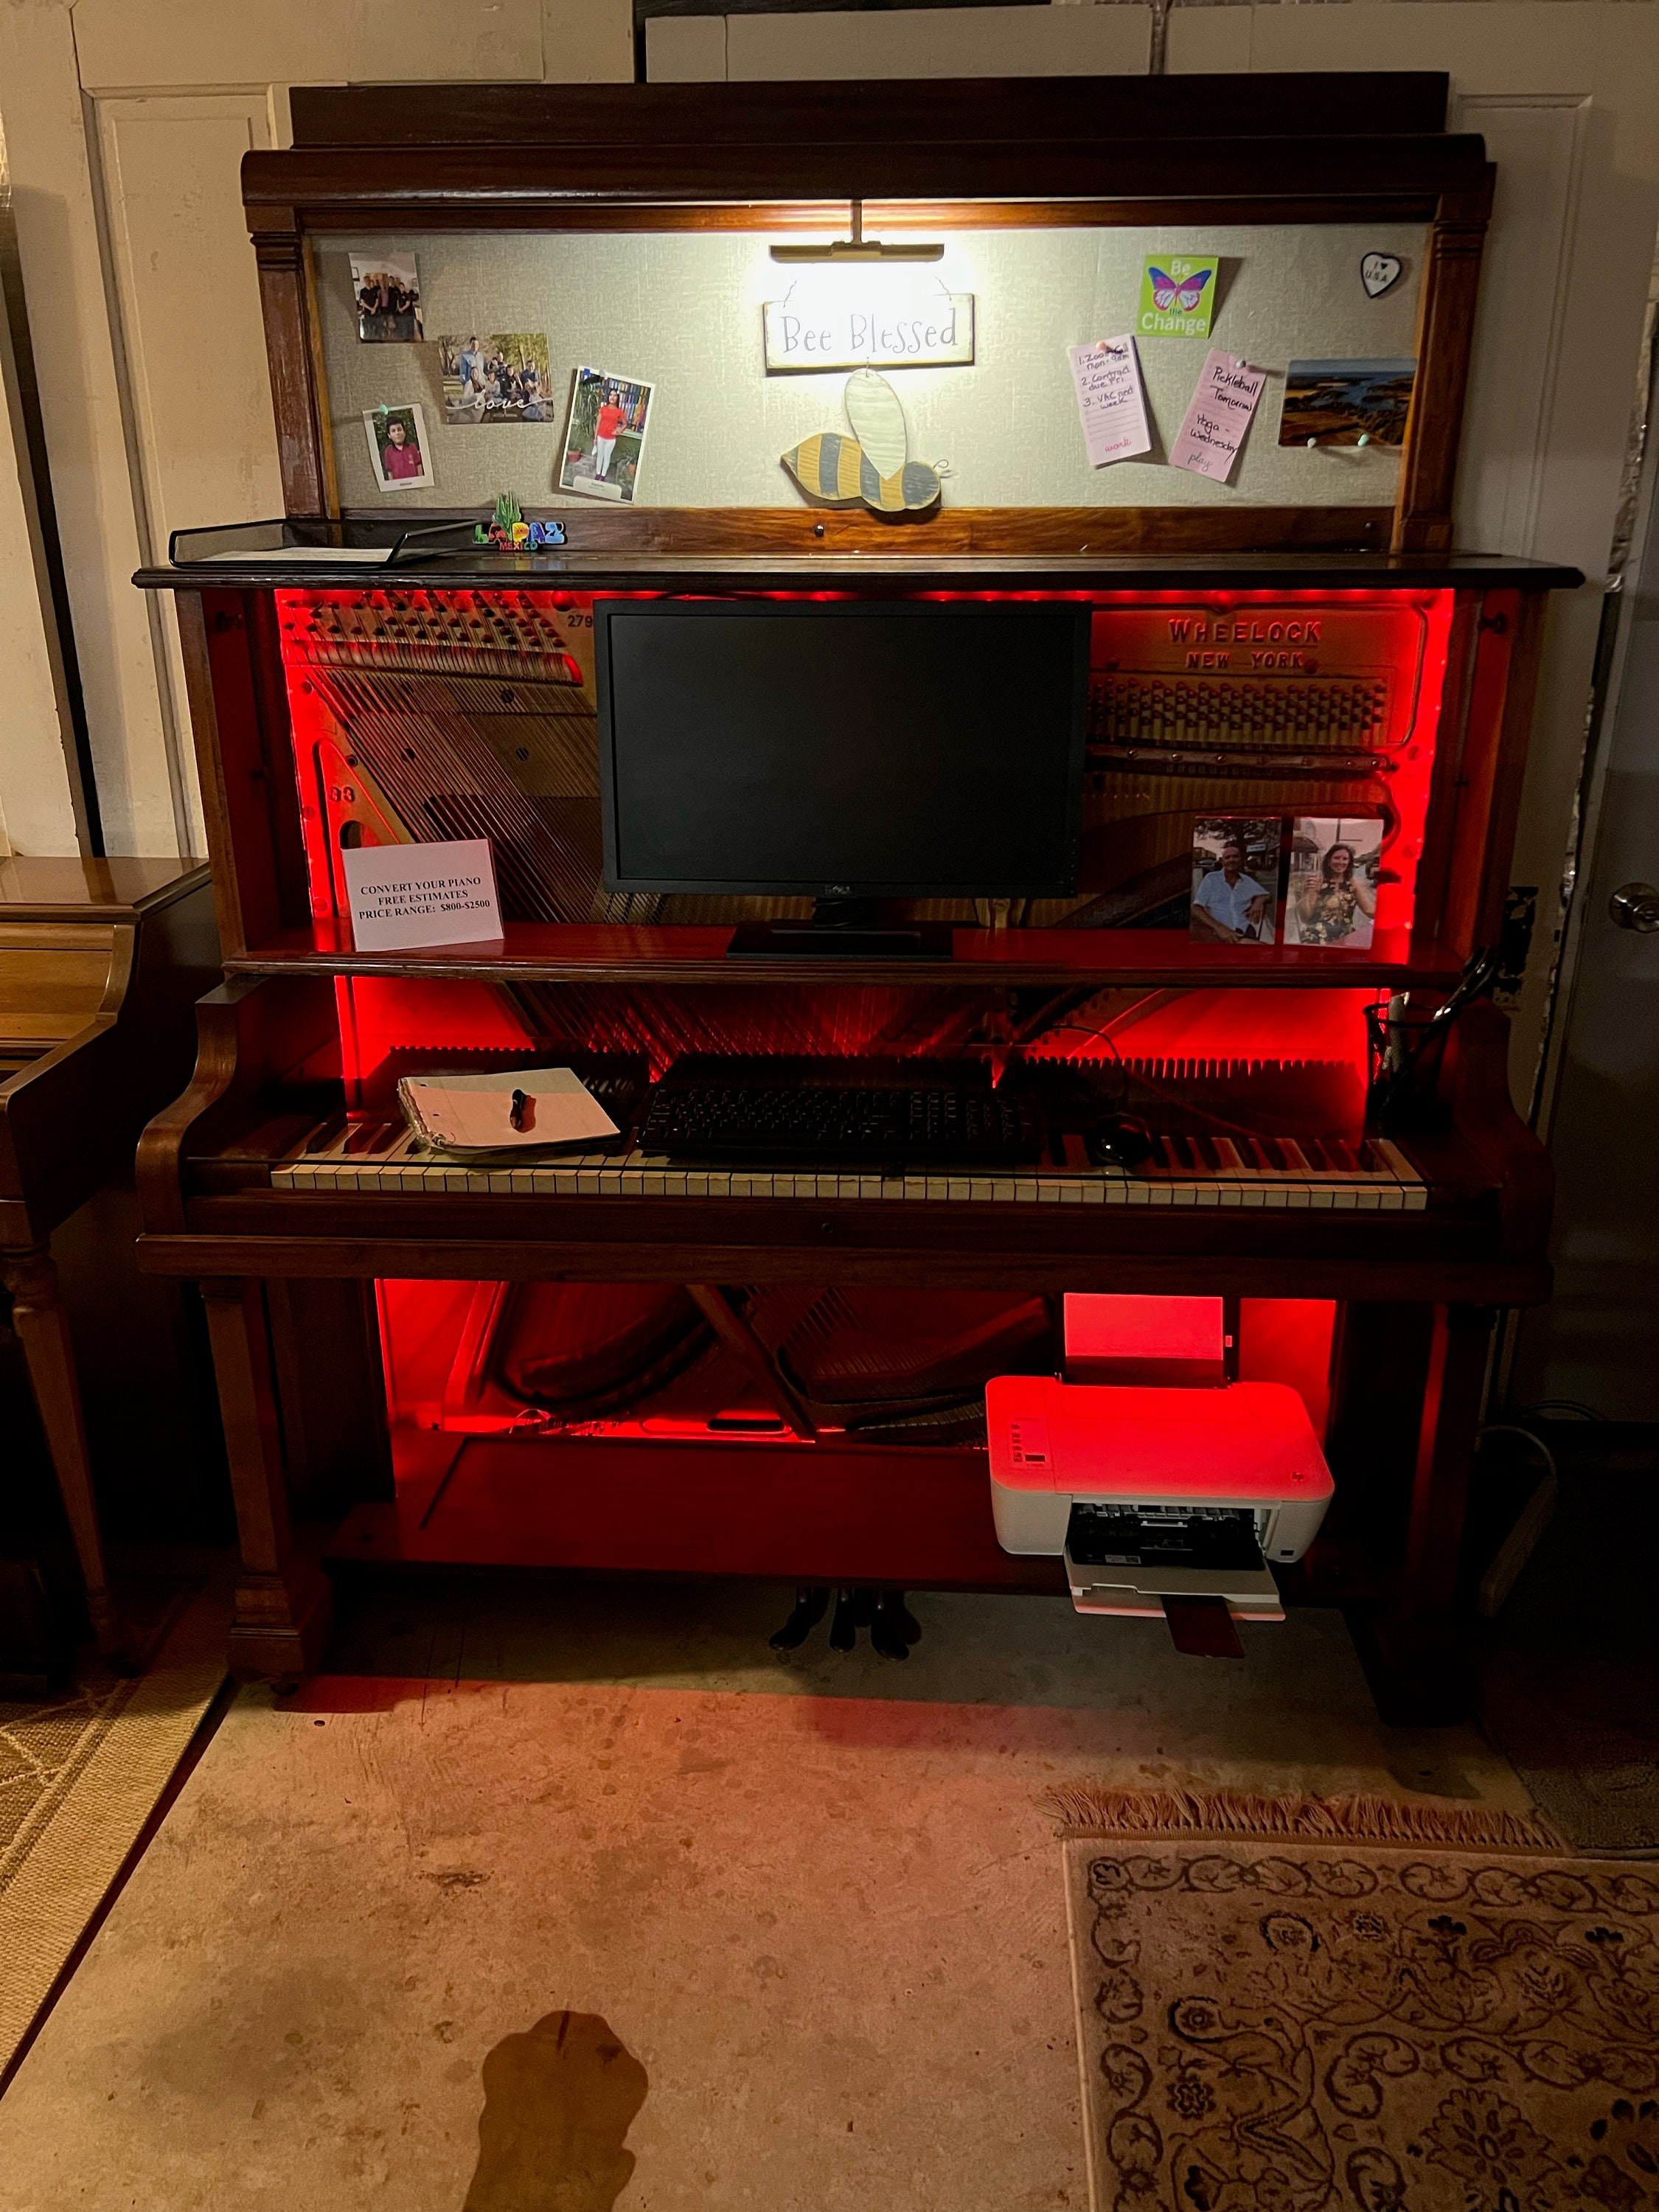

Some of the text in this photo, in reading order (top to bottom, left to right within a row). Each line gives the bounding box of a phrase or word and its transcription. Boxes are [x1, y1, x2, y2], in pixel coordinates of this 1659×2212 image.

[1170, 259, 1191, 276] Be
[779, 307, 959, 354] Bee Blessed
[1141, 312, 1206, 335] Change
[1089, 382, 1107, 391] due
[1213, 366, 1259, 397] Pickleball
[1101, 397, 1128, 409] week
[1210, 385, 1252, 412] Tomorrow
[1197, 414, 1220, 434] Yoga
[1105, 437, 1131, 451] work
[1187, 452, 1212, 473] play
[512, 522, 564, 544] PAZ
[499, 541, 538, 551] MEXICO
[1186, 651, 1304, 669] NEW YORK
[361, 877, 481, 895] CONVERT YOUR PIANO
[378, 889, 468, 905] FREE ESTIMATES
[359, 899, 490, 919] PRICE RANGE: $800-$2500
